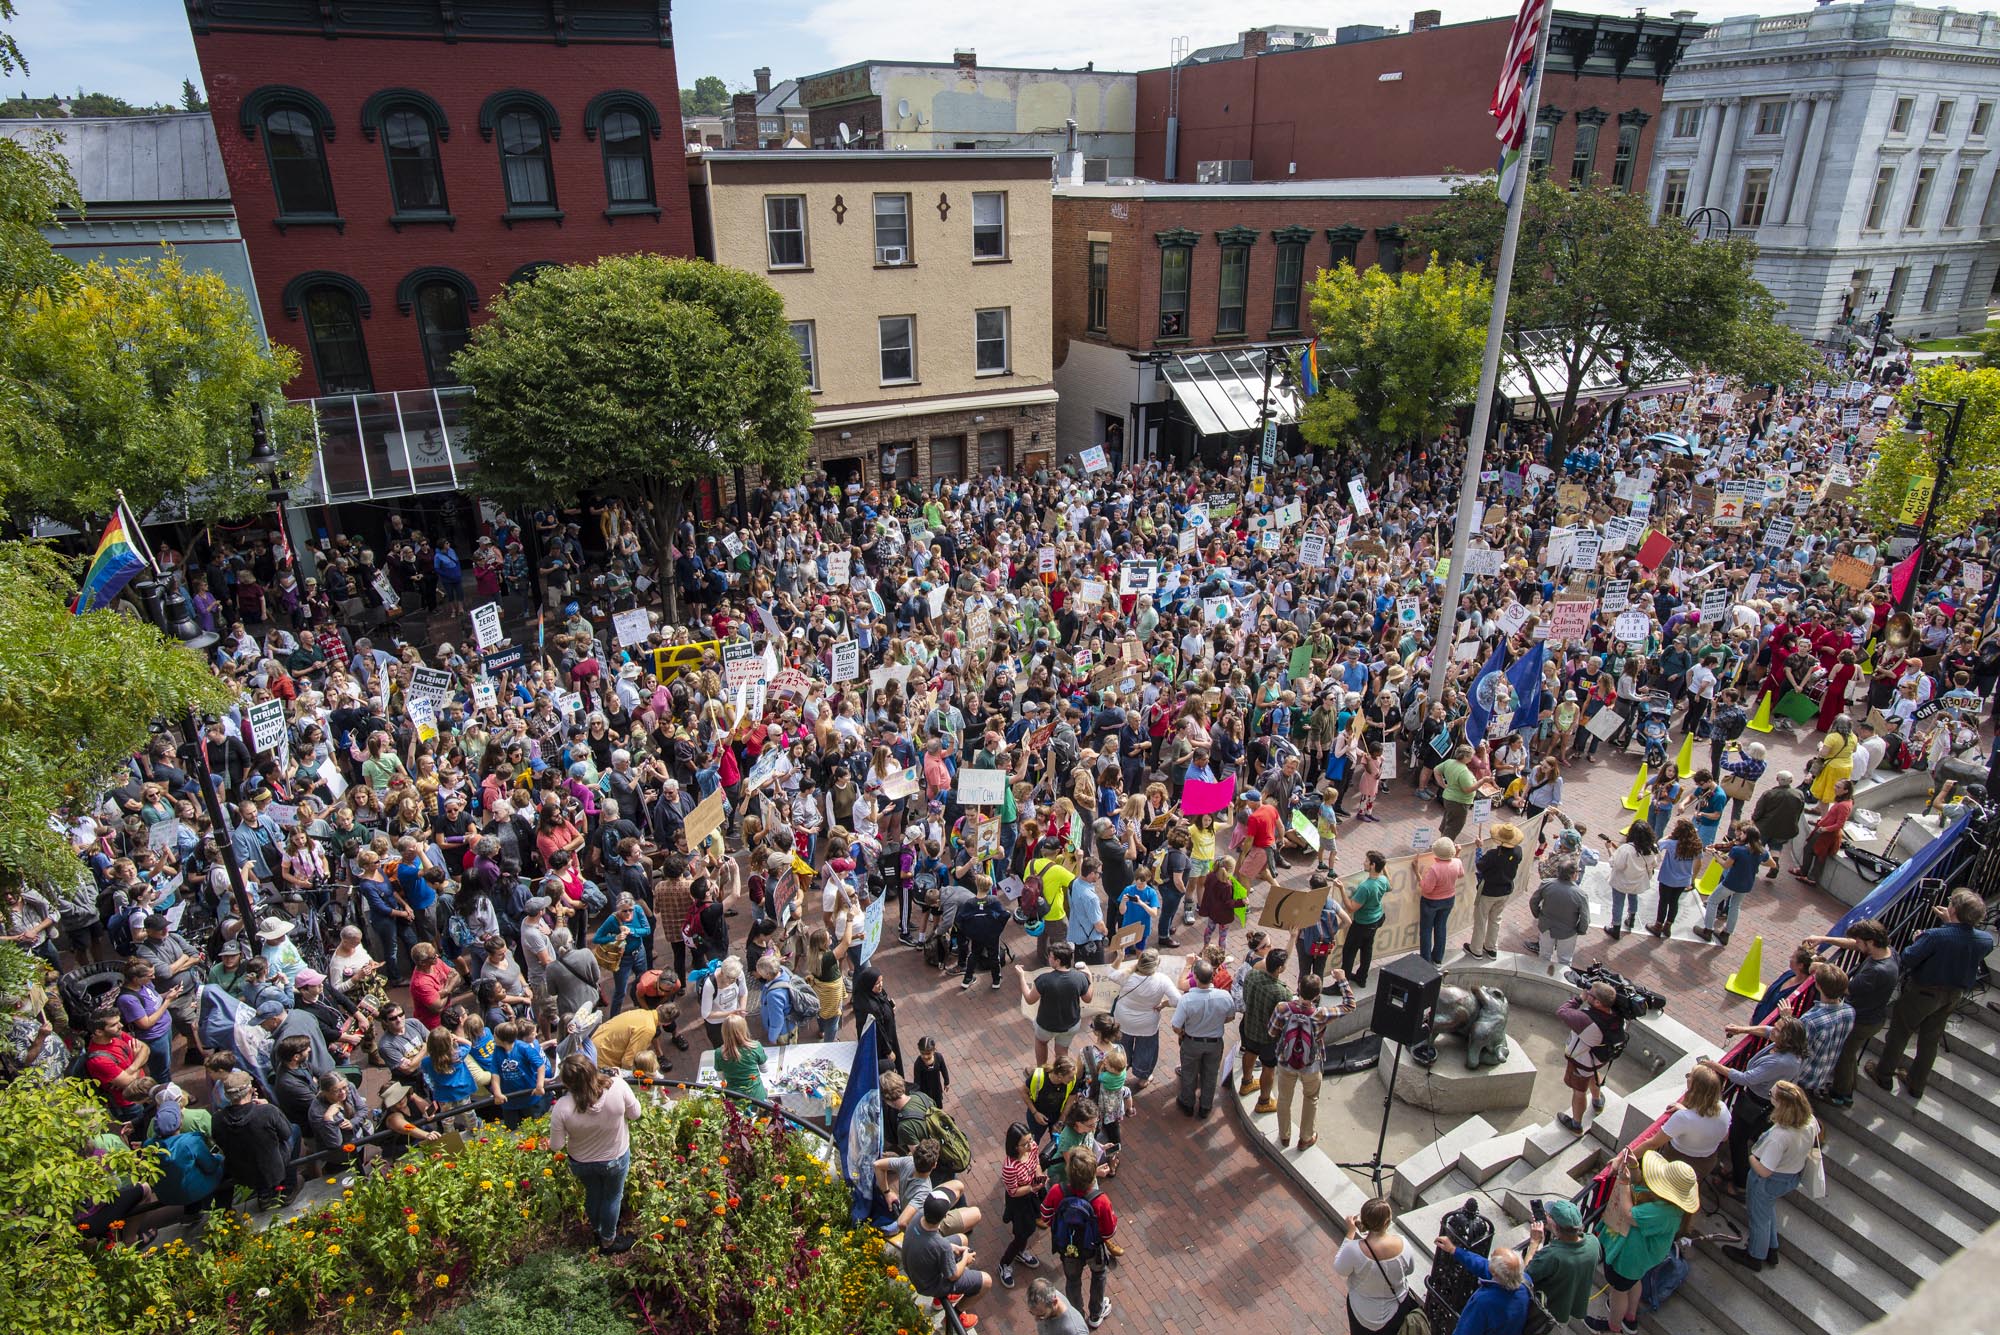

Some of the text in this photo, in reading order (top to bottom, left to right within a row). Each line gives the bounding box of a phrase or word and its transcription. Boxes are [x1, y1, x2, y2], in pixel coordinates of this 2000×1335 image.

[1904, 488, 1919, 514] Artist
[1912, 487, 1930, 521] Market
[1771, 523, 1791, 532] STRIKE
[1765, 537, 1786, 546] NOW!
[1578, 546, 1596, 554] ZERO
[1557, 602, 1592, 613] TRUMP
[1704, 602, 1724, 610] CLIMATE
[478, 614, 496, 627] ZERO
[1553, 616, 1585, 625] Climate
[1703, 612, 1723, 621] NOW!
[1551, 624, 1585, 635] Criminal
[488, 651, 522, 667] Bernie
[726, 649, 752, 658] STRIKE
[837, 651, 856, 661] ZERO
[415, 673, 448, 686] STRIKE
[412, 683, 446, 695] CLIMATE
[1916, 696, 1981, 719] ONE PEOPLE
[252, 706, 281, 722] STRIKE
